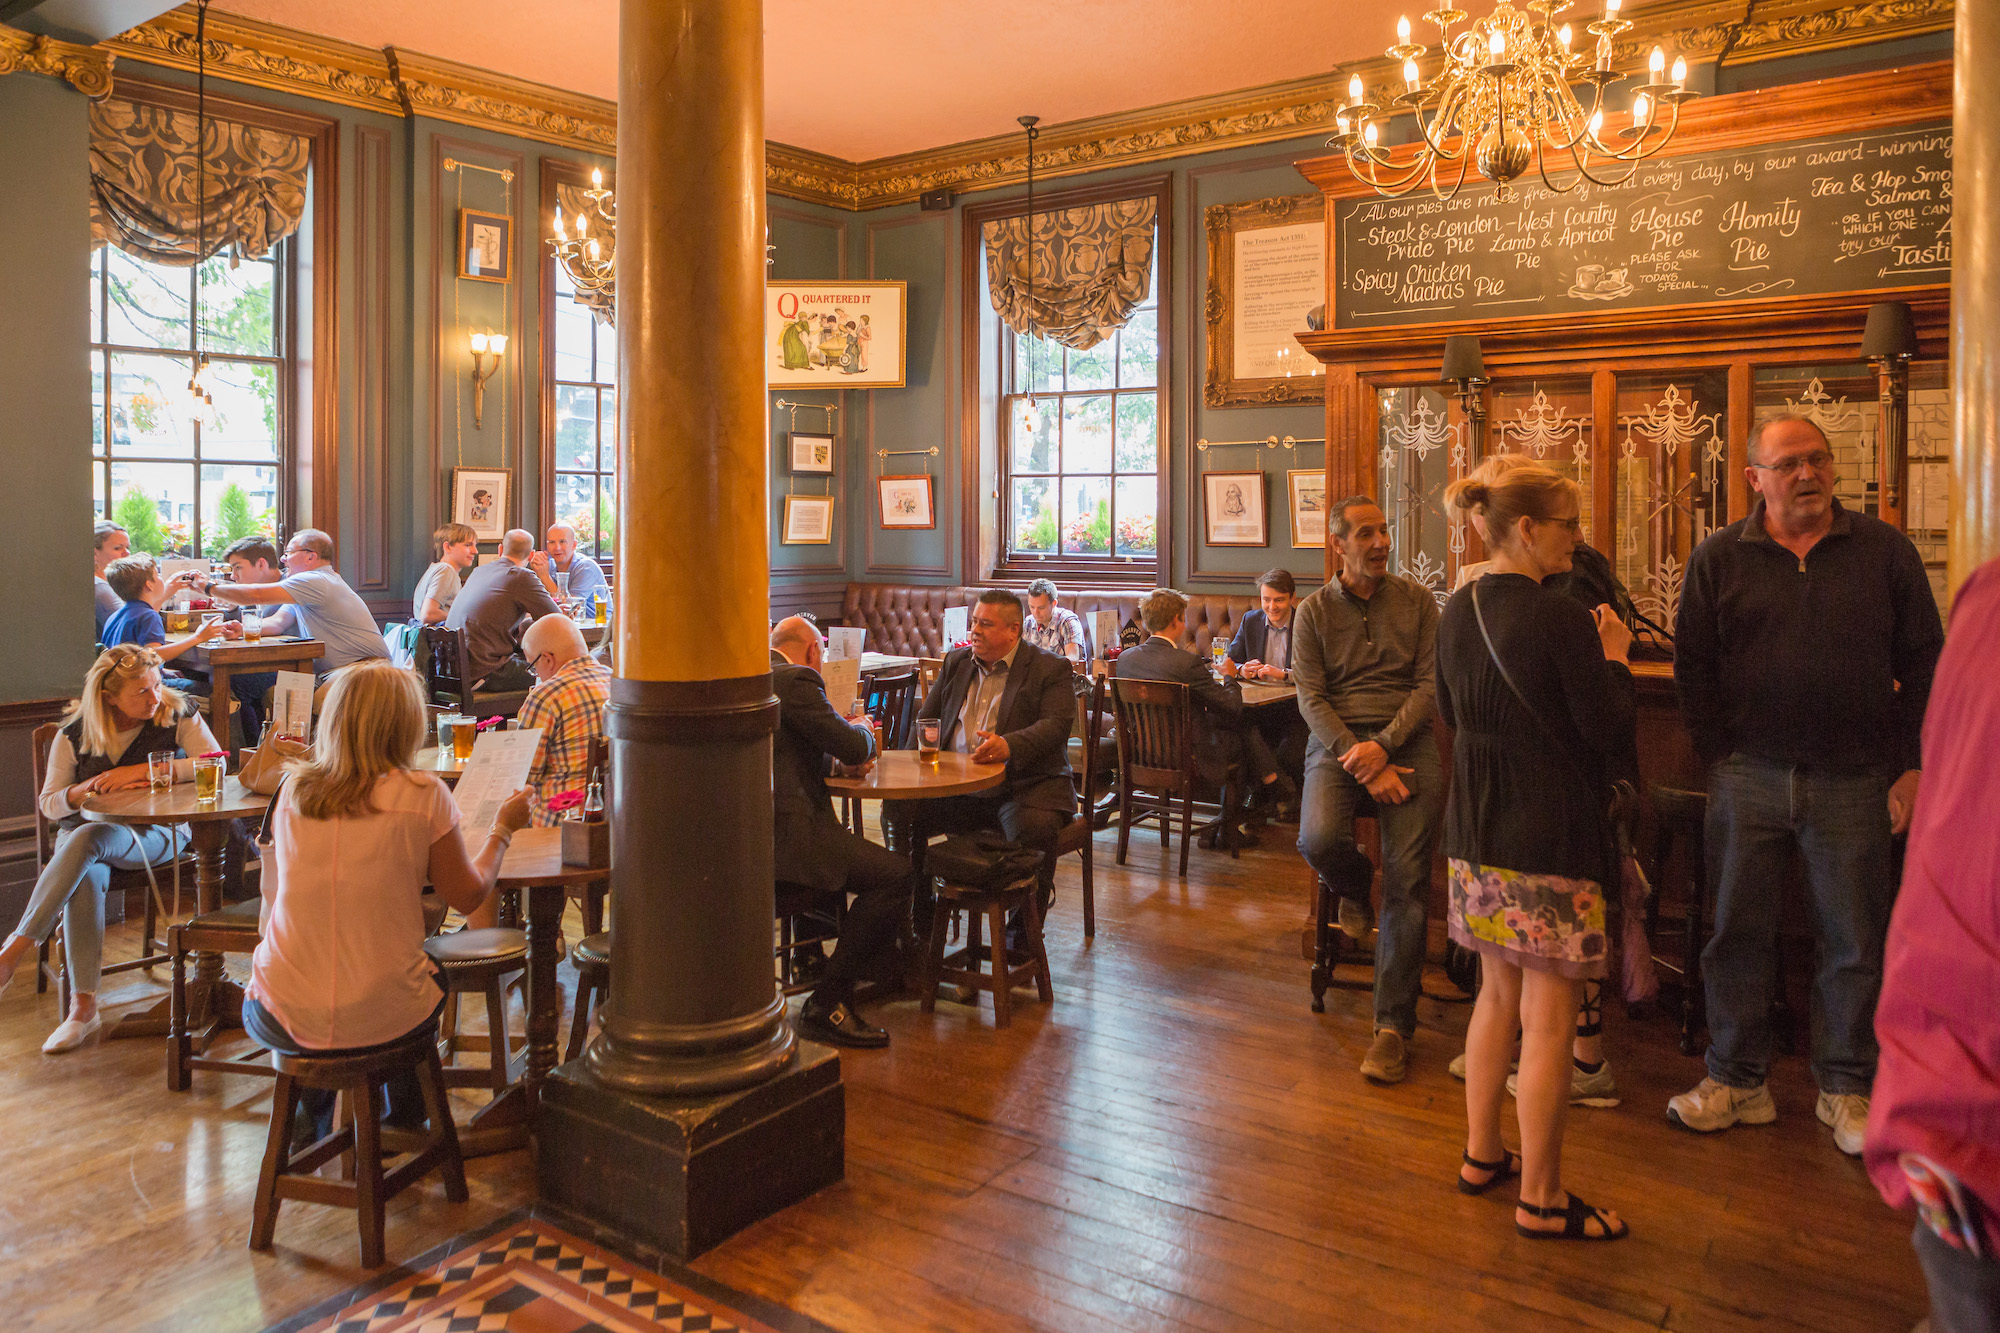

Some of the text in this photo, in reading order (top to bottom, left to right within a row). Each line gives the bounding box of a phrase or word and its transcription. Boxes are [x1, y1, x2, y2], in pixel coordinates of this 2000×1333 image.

[1361, 204, 1387, 222] All
[1389, 204, 1414, 218] our
[1416, 200, 1443, 218] pies
[1446, 197, 1472, 211] are
[1643, 171, 1683, 191] every
[1691, 163, 1729, 186] day,
[1733, 159, 1755, 181] by
[1765, 155, 1797, 171] our
[1811, 165, 1952, 198] Tea & Hop Smo
[1865, 182, 1953, 207] Salmon &
[1564, 201, 1618, 227] Country
[1629, 206, 1704, 233] House
[1718, 197, 1801, 237] Homity
[1868, 211, 1881, 222] IF
[1885, 207, 1915, 221] YOU
[1921, 204, 1950, 216] CAN
[1419, 223, 1433, 241] &
[1431, 214, 1503, 240] London
[1489, 226, 1618, 252] Lamb & Apricot
[1842, 221, 1883, 235] WHICH
[1255, 237, 1278, 245] Treason
[1387, 237, 1476, 262] Pride Pie
[1650, 230, 1685, 251] Pie
[1730, 237, 1770, 263] Pie
[1838, 232, 1901, 257] try our
[1514, 252, 1541, 269] Pie
[1676, 249, 1702, 260] ASK
[1891, 240, 1952, 267] Tasti
[1406, 261, 1471, 286] Chicken
[1639, 272, 1679, 284] TODAYS
[1655, 261, 1682, 273] FOR
[1352, 268, 1398, 296] Spicy
[1393, 276, 1506, 304] Madras Pie
[777, 292, 799, 320] Q
[802, 294, 871, 304] QUARTERED IT
